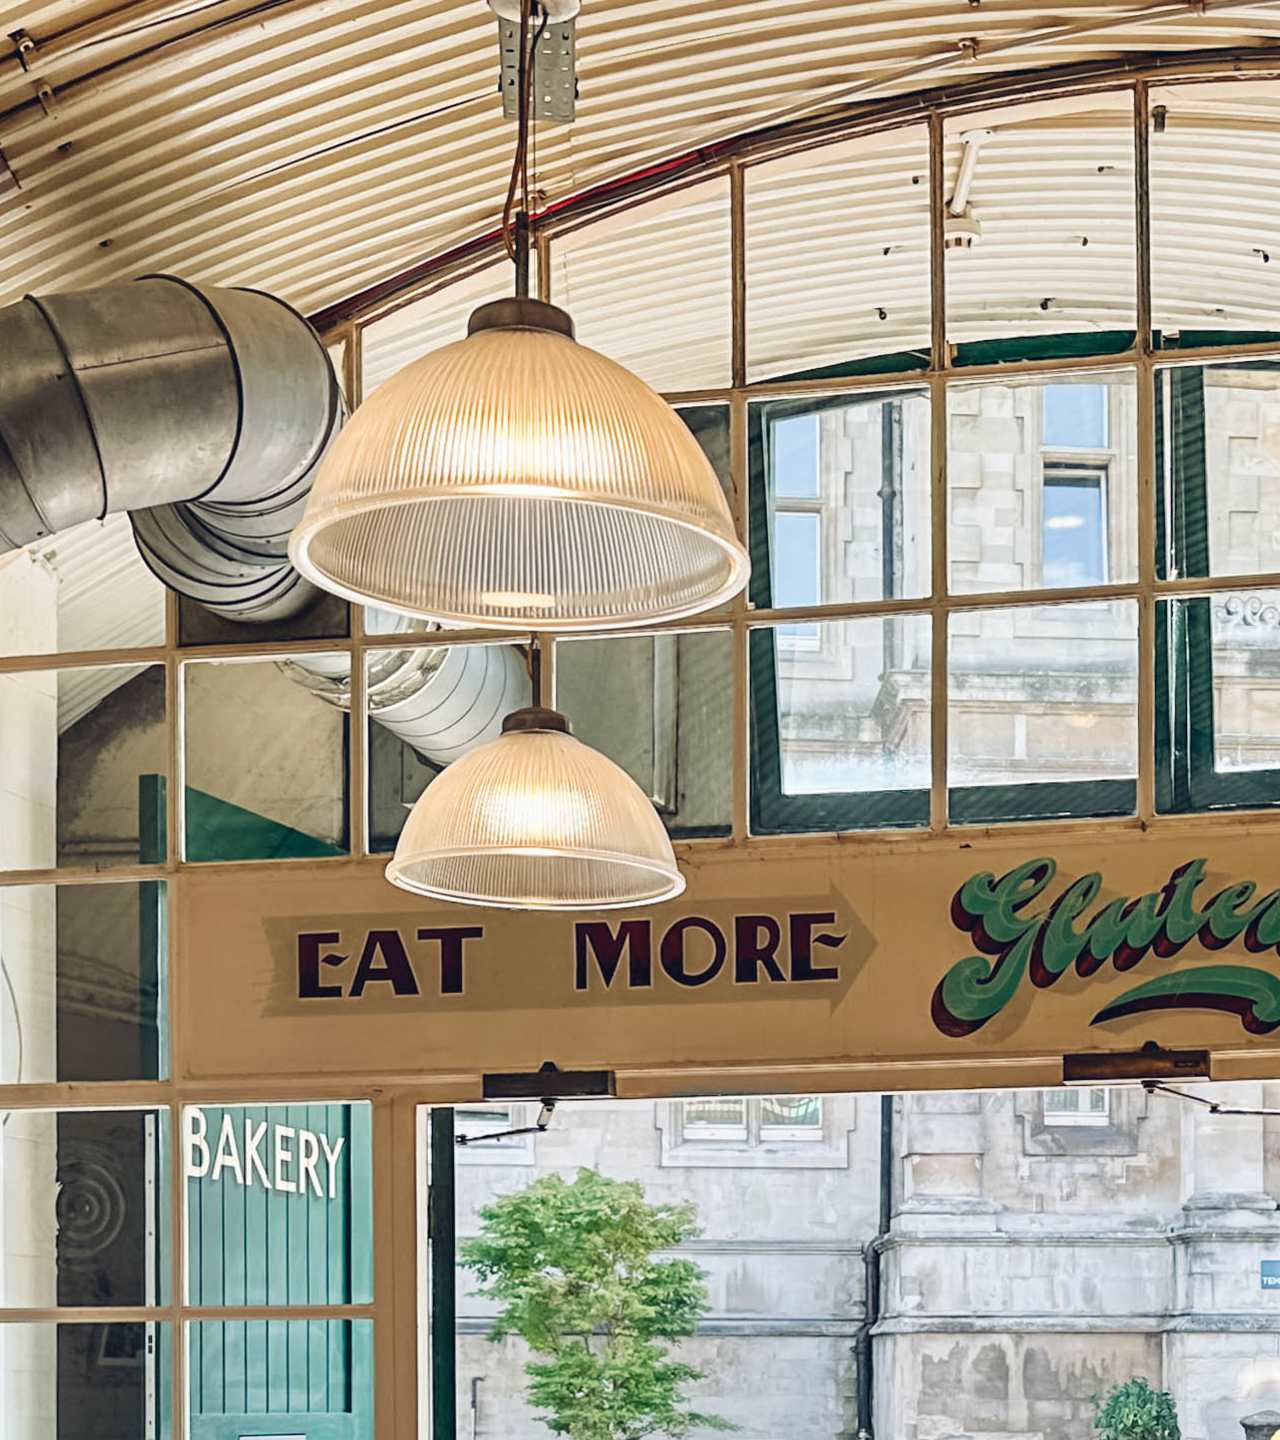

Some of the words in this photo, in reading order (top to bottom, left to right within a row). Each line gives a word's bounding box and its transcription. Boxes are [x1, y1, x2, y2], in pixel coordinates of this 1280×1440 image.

[297, 926, 484, 998] EAT
[574, 912, 849, 991] MORE
[184, 1106, 345, 1199] BAKERY
